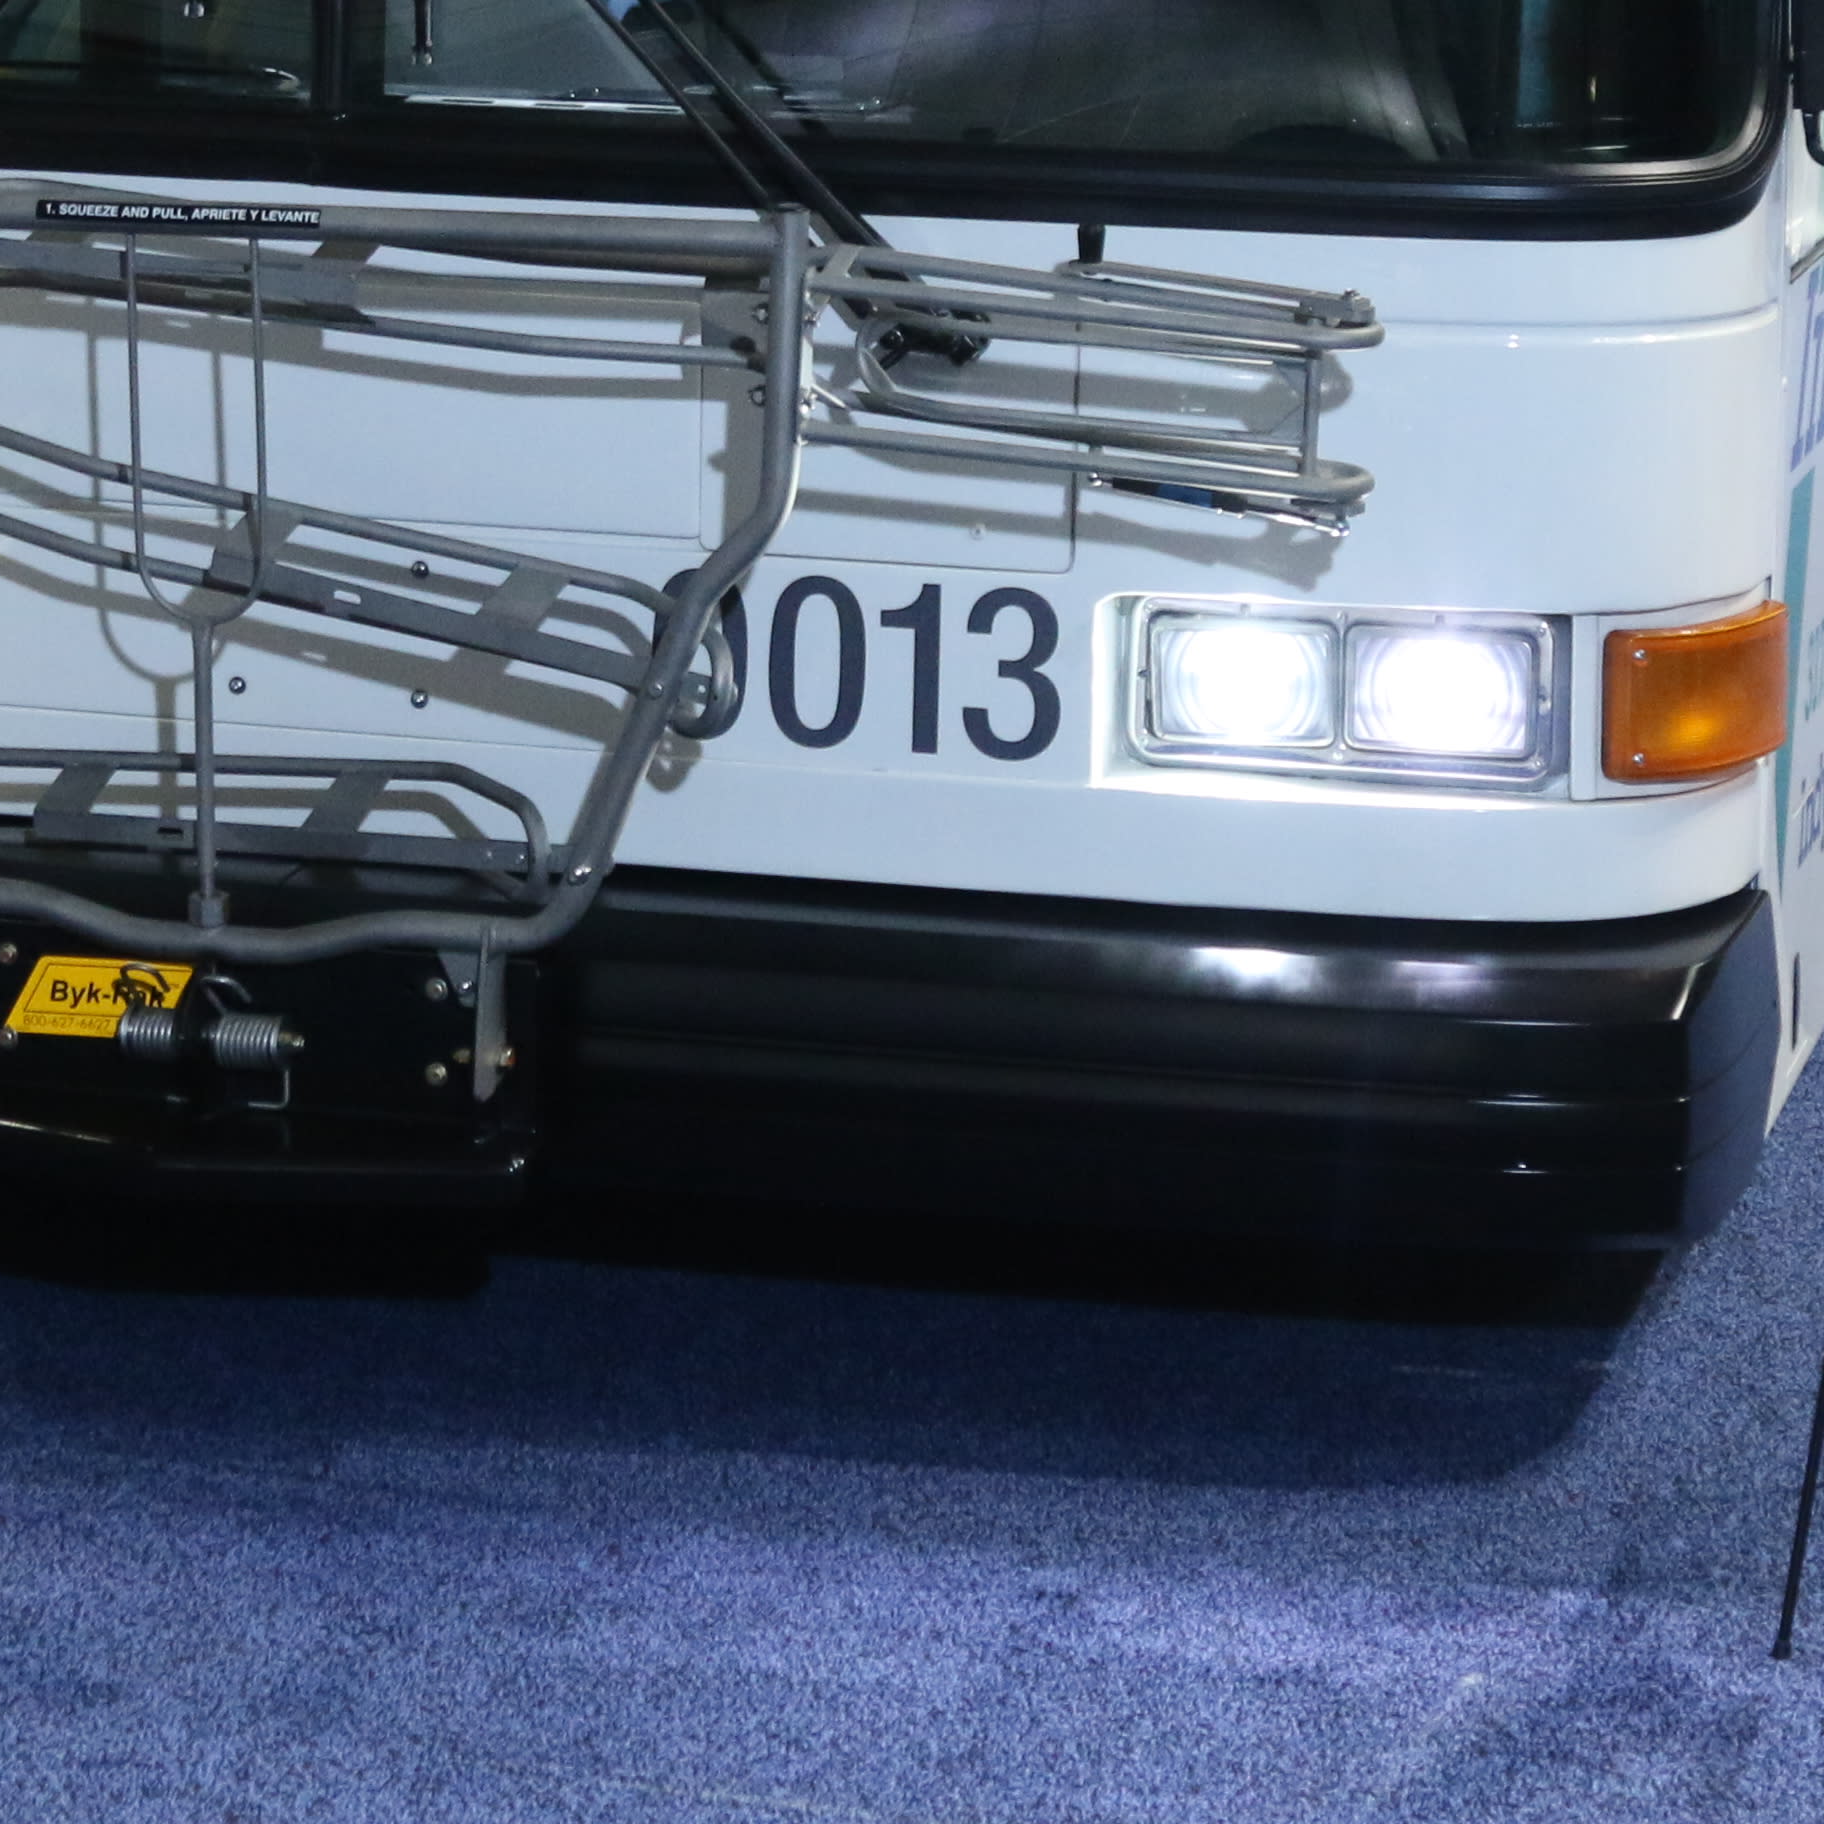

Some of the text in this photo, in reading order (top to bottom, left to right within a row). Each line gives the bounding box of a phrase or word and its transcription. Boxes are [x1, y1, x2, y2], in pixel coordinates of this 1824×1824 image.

[44, 202, 320, 225] 1. SQUEEZE AND PULL, APRIETE Y LEVANTE
